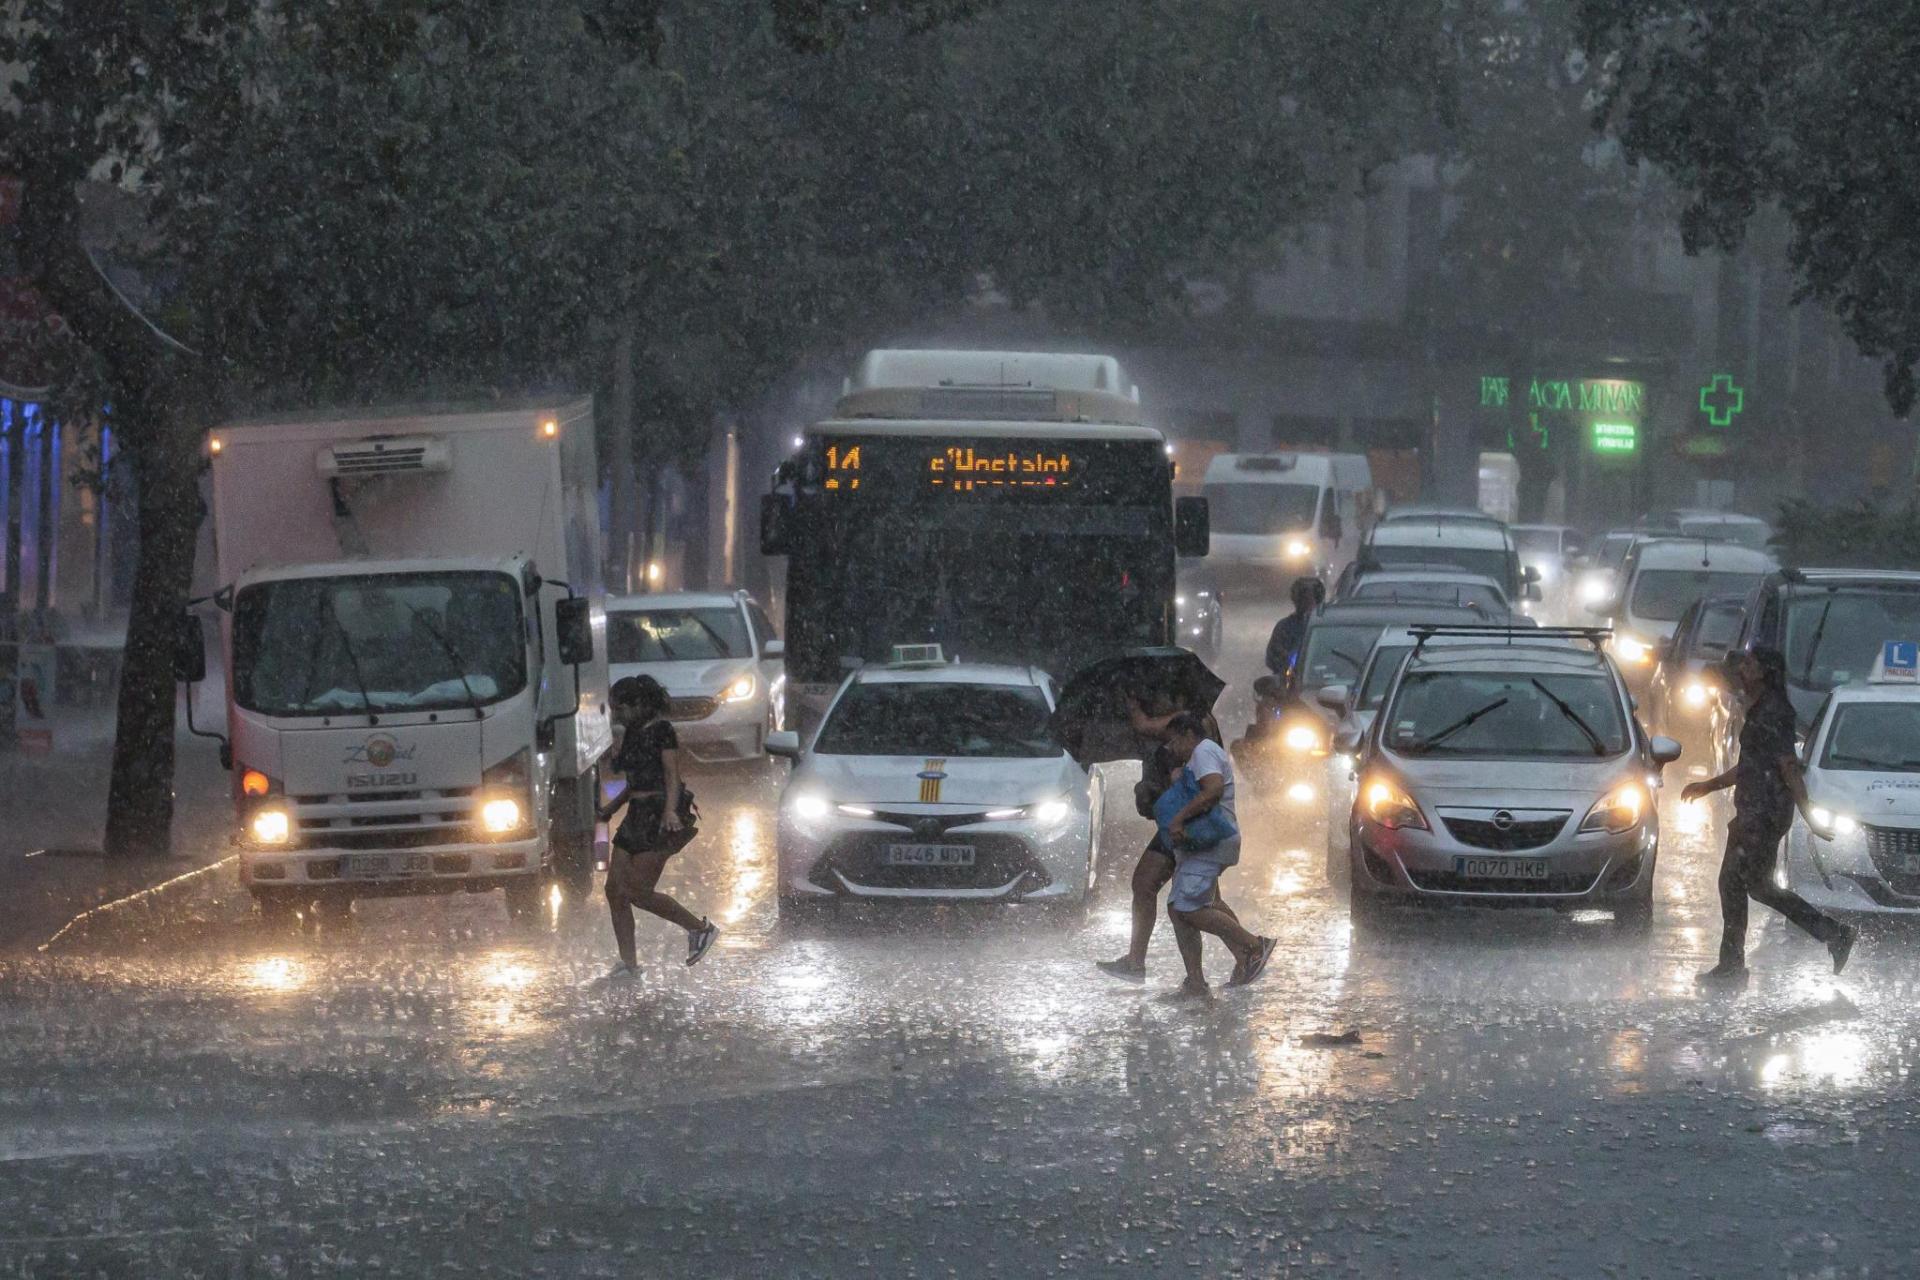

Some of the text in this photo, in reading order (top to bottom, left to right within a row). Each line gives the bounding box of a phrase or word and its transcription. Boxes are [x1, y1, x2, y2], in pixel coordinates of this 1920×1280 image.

[1893, 645, 1908, 665] L
[347, 773, 417, 788] ISUZU
[1468, 861, 1509, 876] 0070
